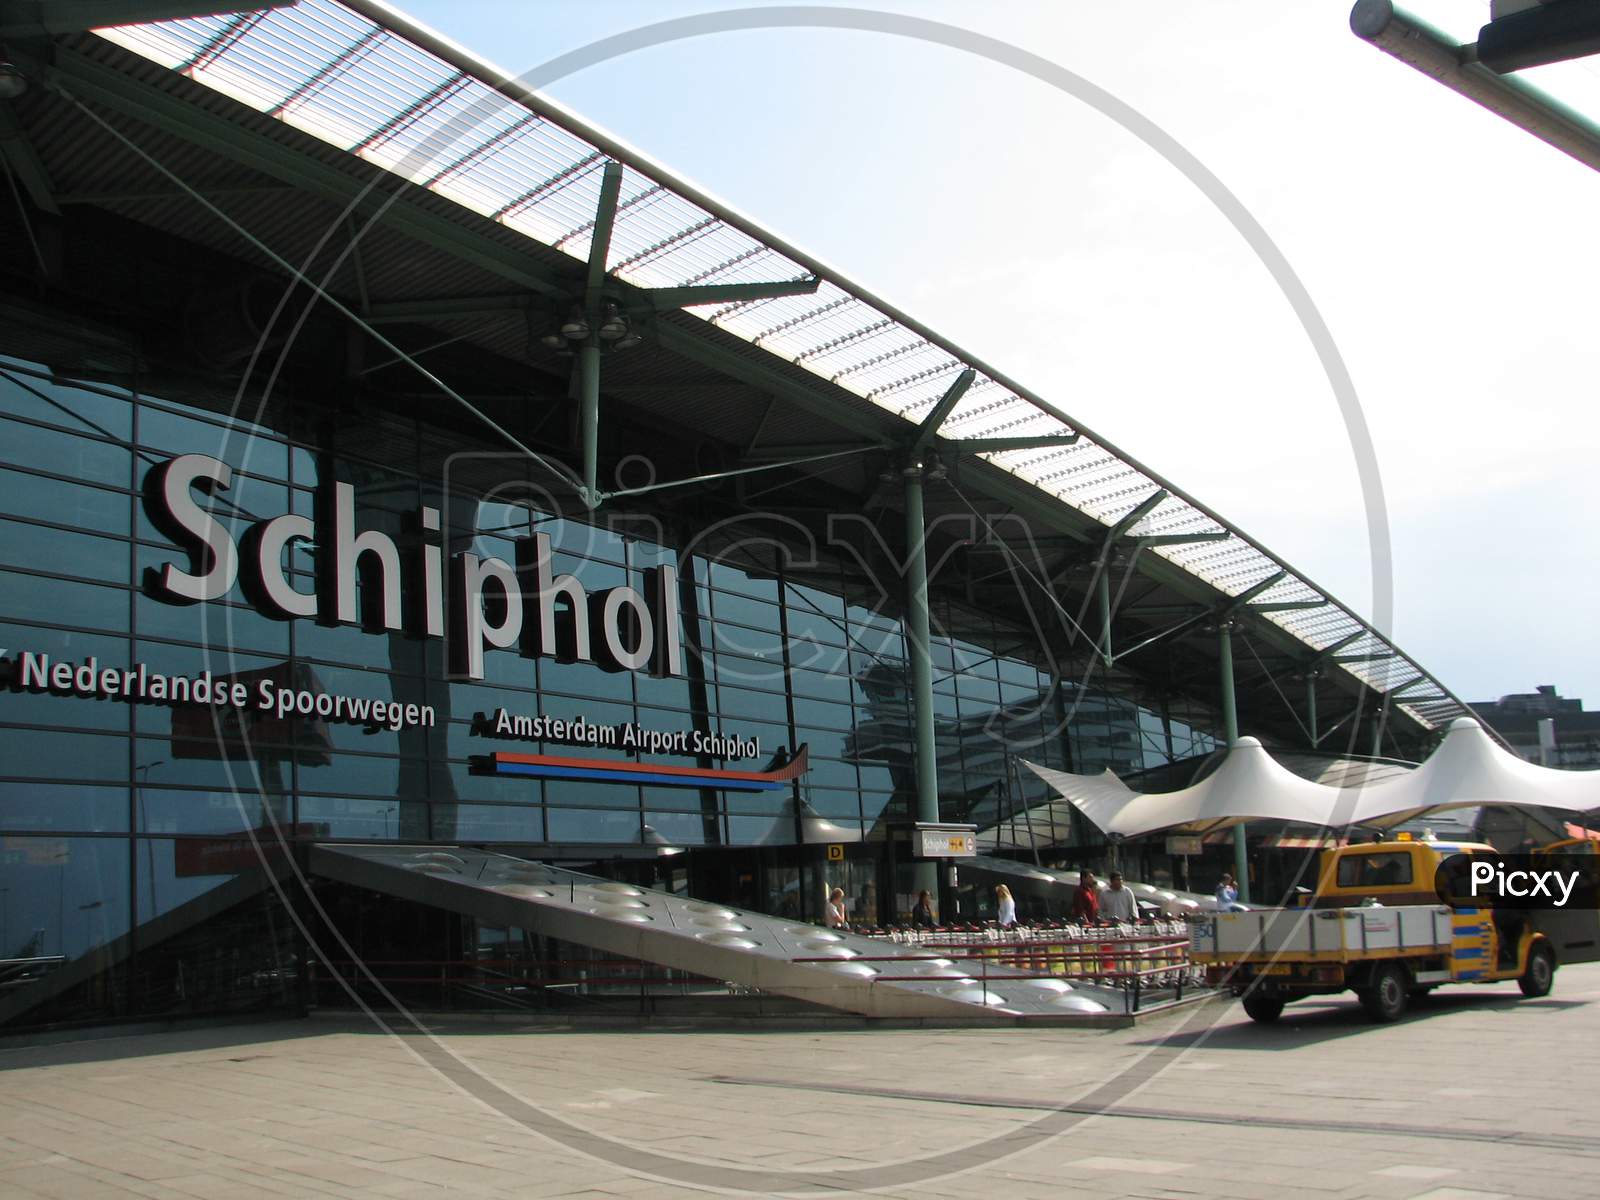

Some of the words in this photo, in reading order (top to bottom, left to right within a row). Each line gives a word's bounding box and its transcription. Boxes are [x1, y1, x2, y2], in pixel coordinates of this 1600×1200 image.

[164, 453, 682, 680] Schiphol
[21, 651, 248, 707] Nederlandse
[258, 679, 435, 732] Spoorwegen
[496, 708, 616, 745] Amsterdam
[622, 722, 688, 752] Airport
[693, 730, 760, 761] Schiphol
[830, 846, 841, 859] D
